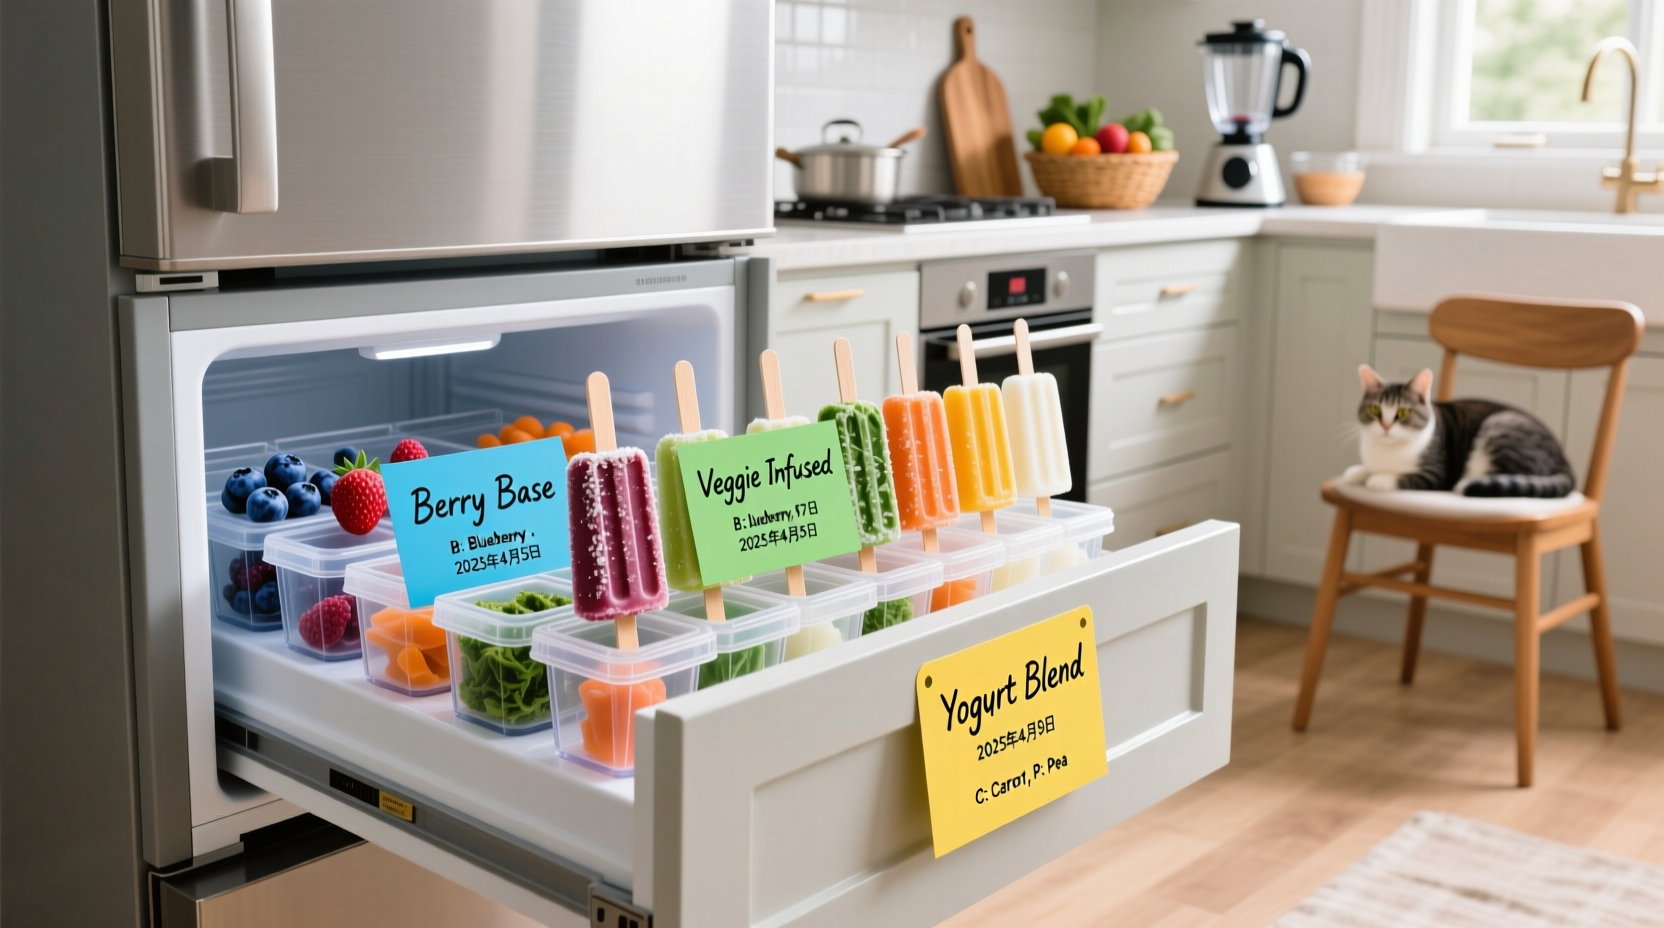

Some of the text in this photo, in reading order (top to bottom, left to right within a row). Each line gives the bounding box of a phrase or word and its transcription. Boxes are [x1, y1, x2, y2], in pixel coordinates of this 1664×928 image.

[697, 448, 833, 505] Veggie Infused
[411, 474, 555, 526] Berry Base
[454, 544, 541, 575] 2025年4月5日
[739, 522, 818, 552] 2025年4月5日
[940, 642, 1085, 736] Yogurt Blend
[977, 715, 1055, 761] 2025年4月9日
[1033, 763, 1045, 779] P:
[1047, 755, 1068, 774] Pea
